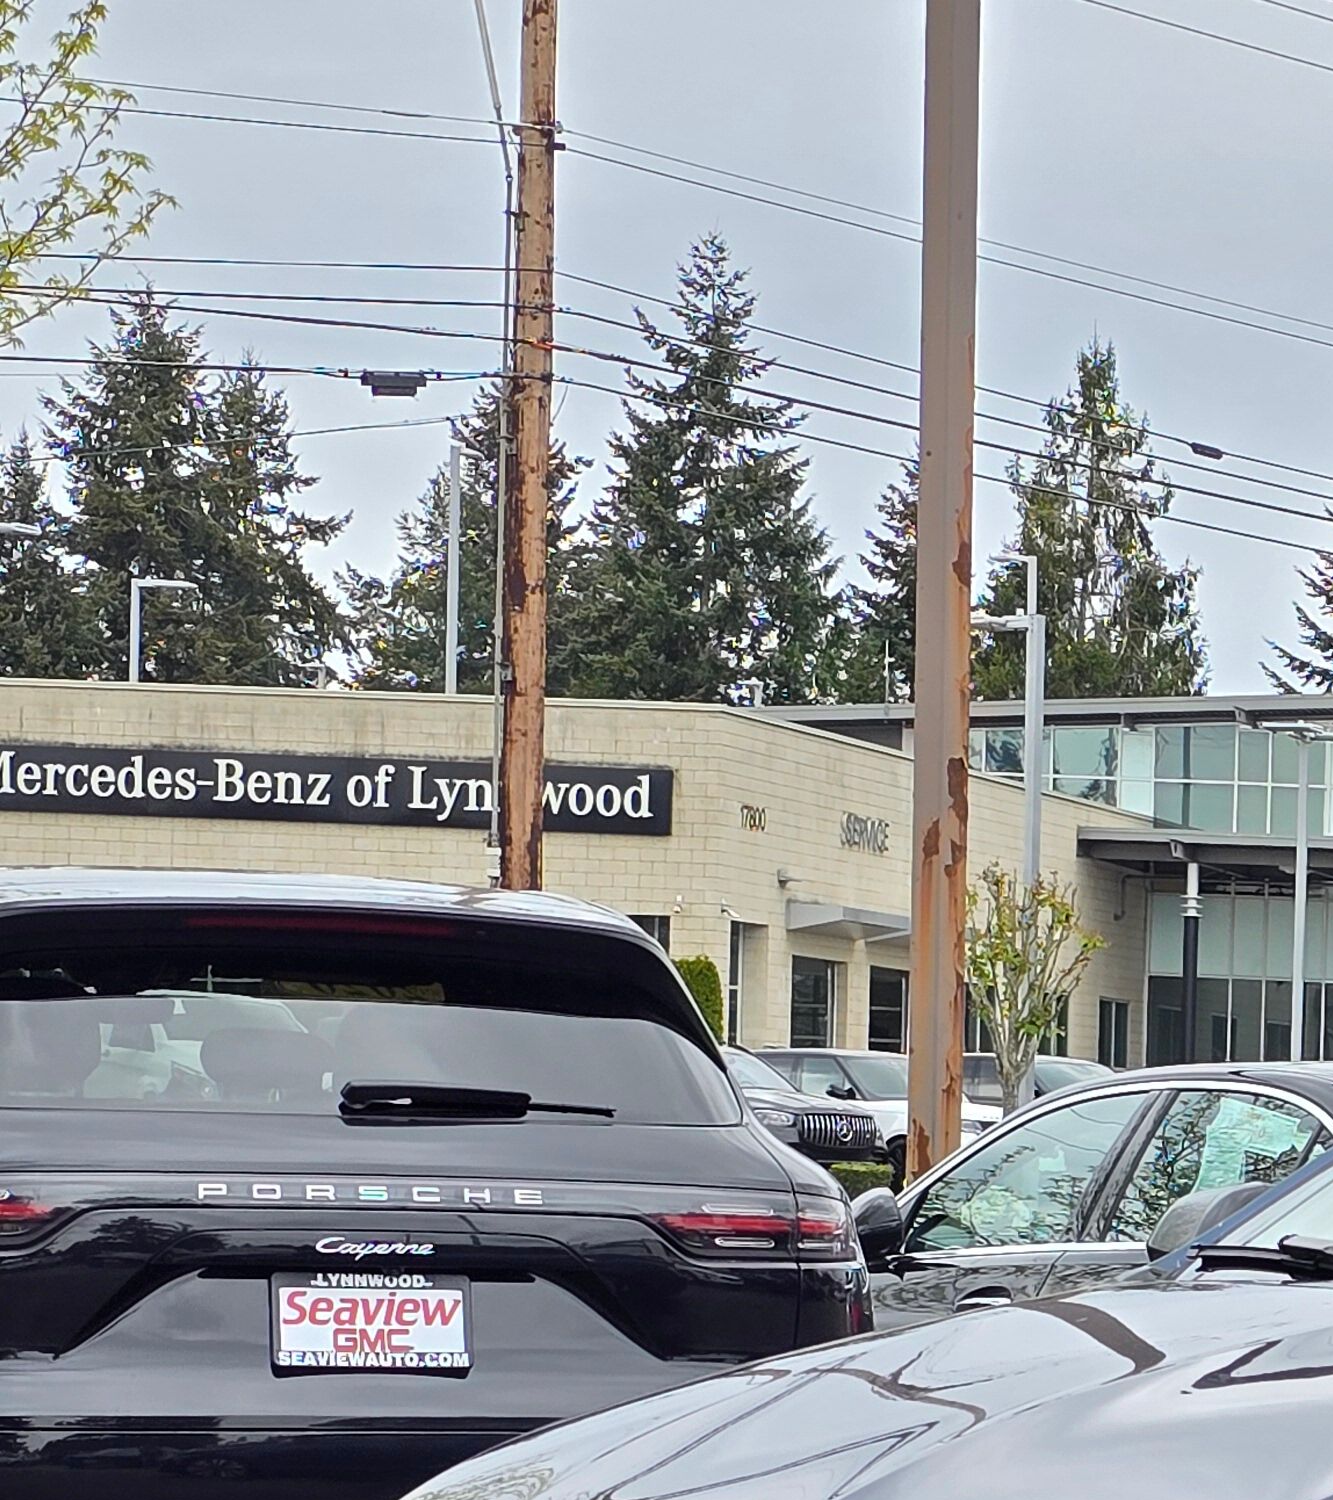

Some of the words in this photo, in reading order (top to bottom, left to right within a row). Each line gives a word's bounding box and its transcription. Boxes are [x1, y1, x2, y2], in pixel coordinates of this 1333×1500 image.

[346, 765, 396, 808] of
[407, 766, 654, 821] Lynwood
[197, 1183, 544, 1205] PORSCHE
[315, 1236, 436, 1262] Cayenne
[315, 1273, 426, 1288] LYNNWOOD
[282, 1290, 462, 1327] Seaview
[332, 1328, 413, 1353] GMC
[278, 1351, 470, 1368] SEAVIEWAUTO.COM
